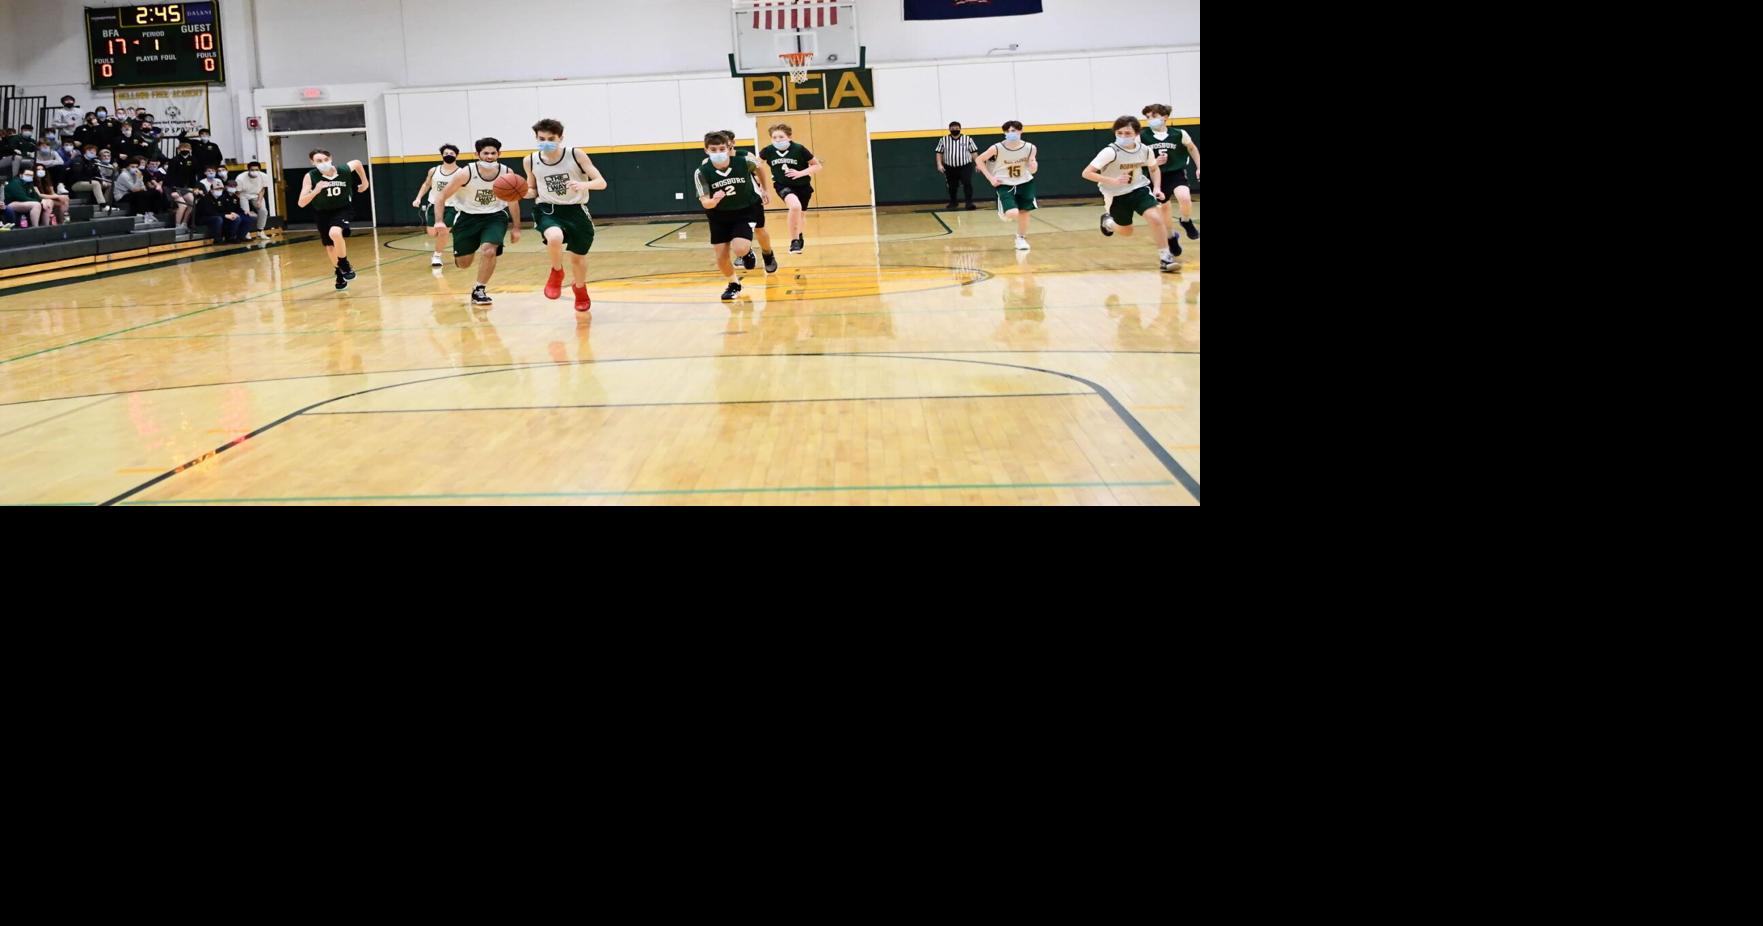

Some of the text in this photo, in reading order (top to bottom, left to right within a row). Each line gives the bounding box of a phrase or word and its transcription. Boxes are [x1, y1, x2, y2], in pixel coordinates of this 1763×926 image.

[136, 5, 180, 24] 2:45
[102, 29, 120, 38] BFA
[181, 24, 211, 33] GUEST
[108, 38, 127, 55] 17
[154, 38, 159, 51] 1
[194, 33, 213, 51] 10
[102, 64, 113, 77] 0
[204, 58, 215, 72] 0
[744, 71, 872, 112] BFA
[1007, 165, 1021, 178] 15
[711, 177, 746, 189] ENOSBURG
[327, 187, 341, 197] 10
[724, 185, 736, 196] 2
